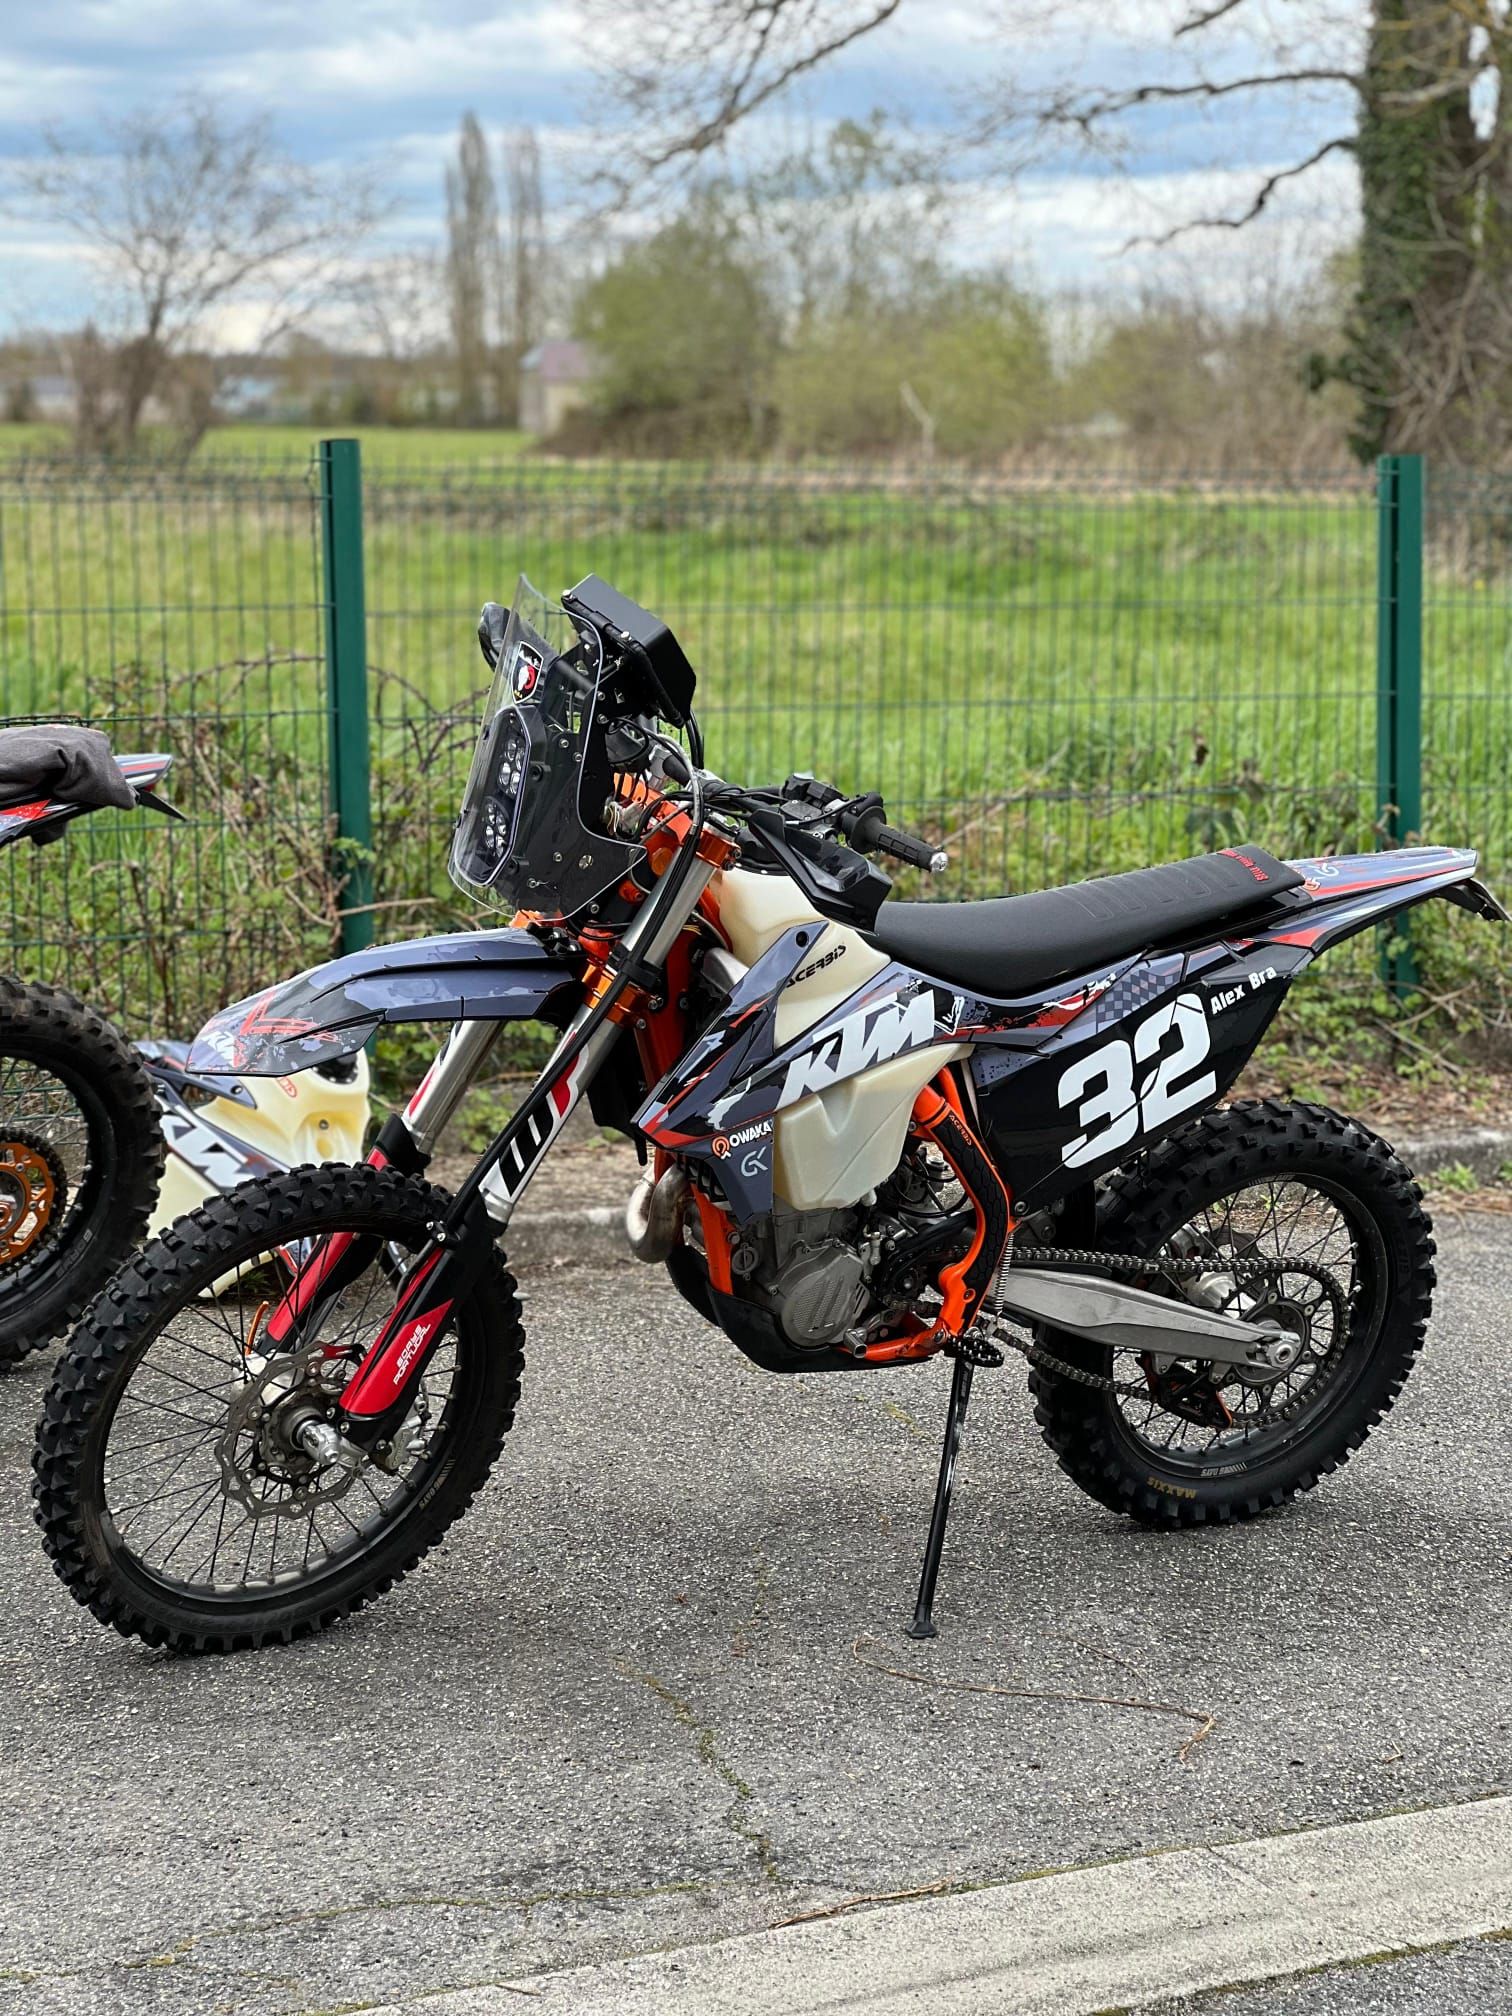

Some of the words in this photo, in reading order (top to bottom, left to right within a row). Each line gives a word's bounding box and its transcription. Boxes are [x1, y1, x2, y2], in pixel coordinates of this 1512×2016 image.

[1209, 985, 1246, 1015] Alex
[1248, 966, 1278, 991] Bra
[777, 989, 935, 1111] KTM
[1057, 993, 1217, 1169] 32
[393, 1323, 431, 1385] PORTUGAL
[1146, 1476, 1197, 1499] MAXXIS
